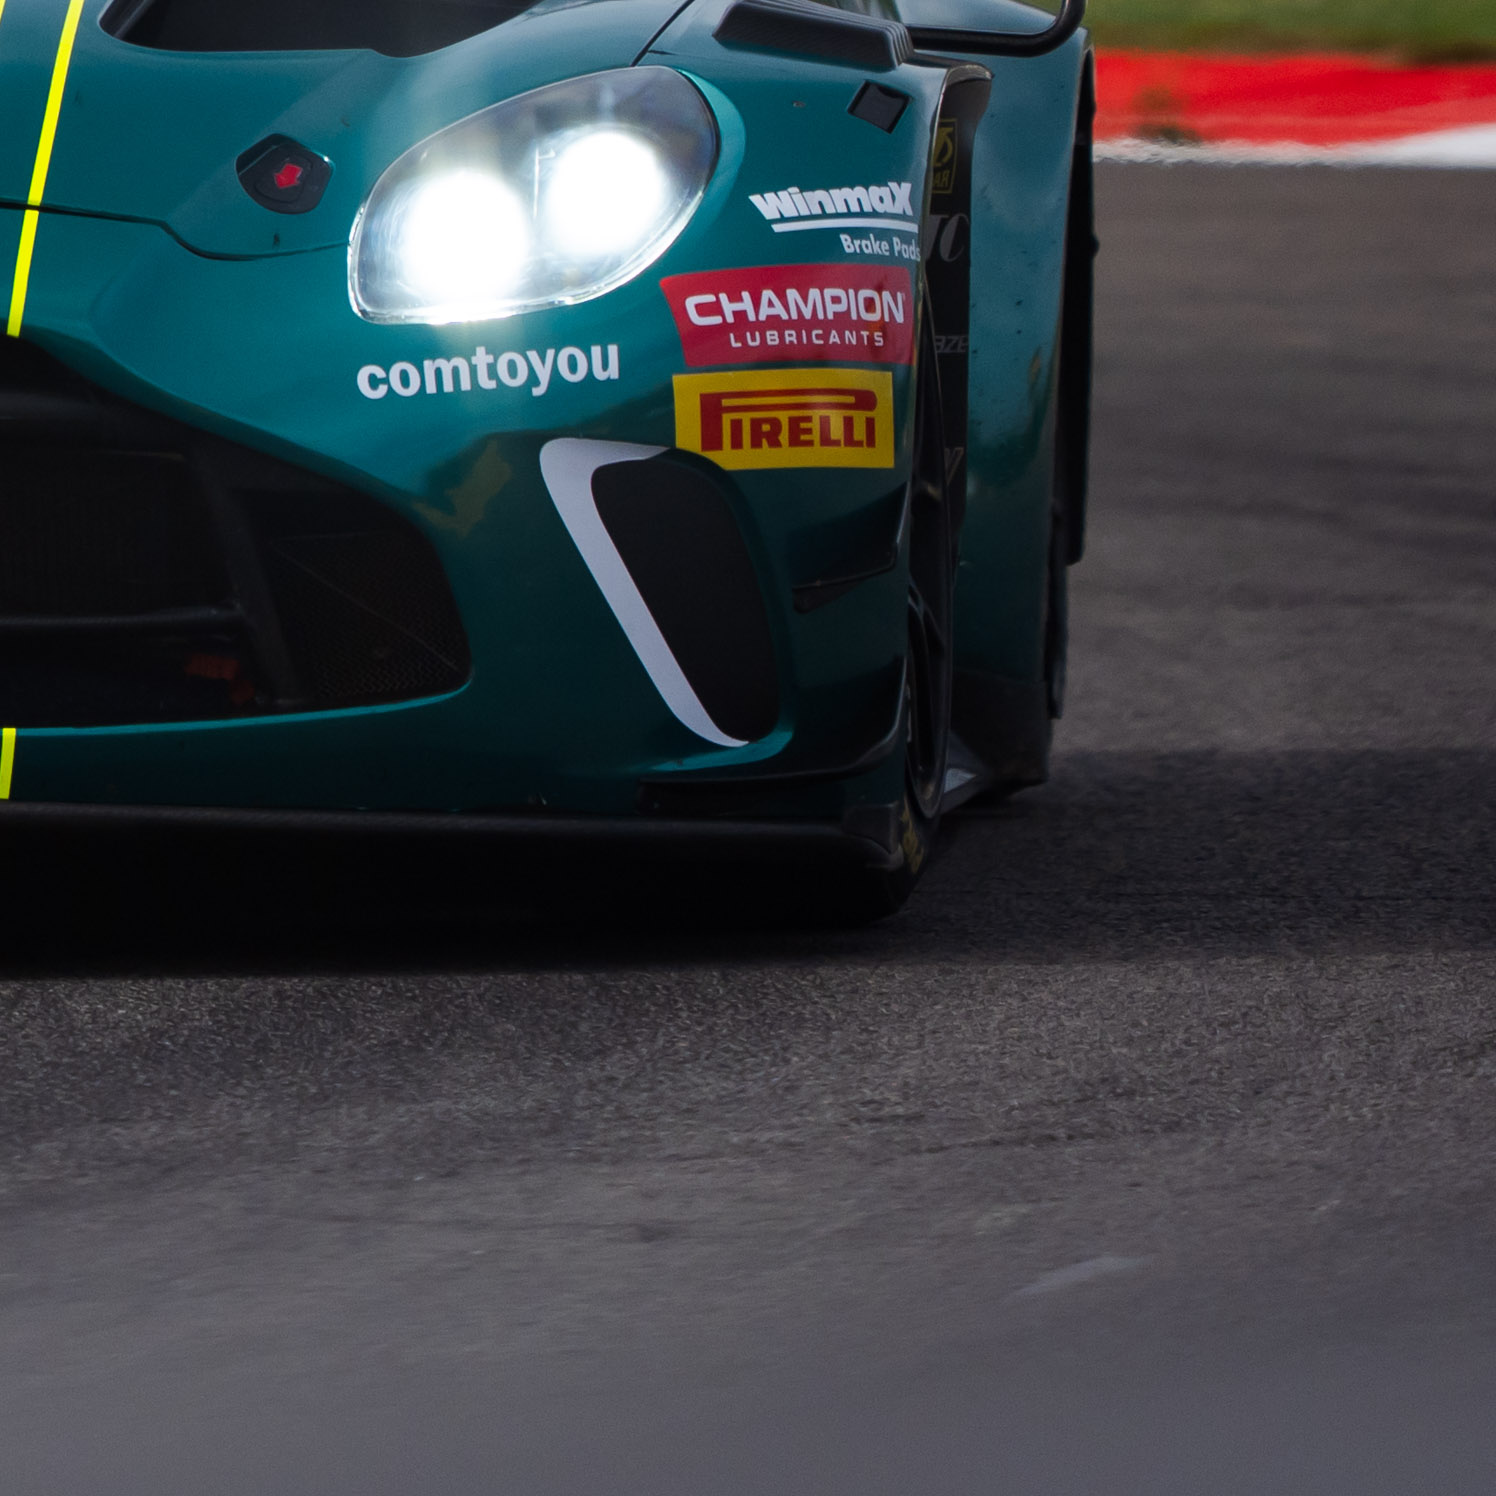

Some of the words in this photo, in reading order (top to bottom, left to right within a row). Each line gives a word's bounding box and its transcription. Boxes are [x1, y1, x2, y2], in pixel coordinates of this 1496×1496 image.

[839, 233, 891, 256] Brake
[892, 236, 921, 262] Pads
[685, 288, 905, 327] CHAMPION
[730, 329, 885, 348] LUBRICANTS
[357, 344, 620, 397] comtoyou
[699, 388, 878, 452] PIRELLI
